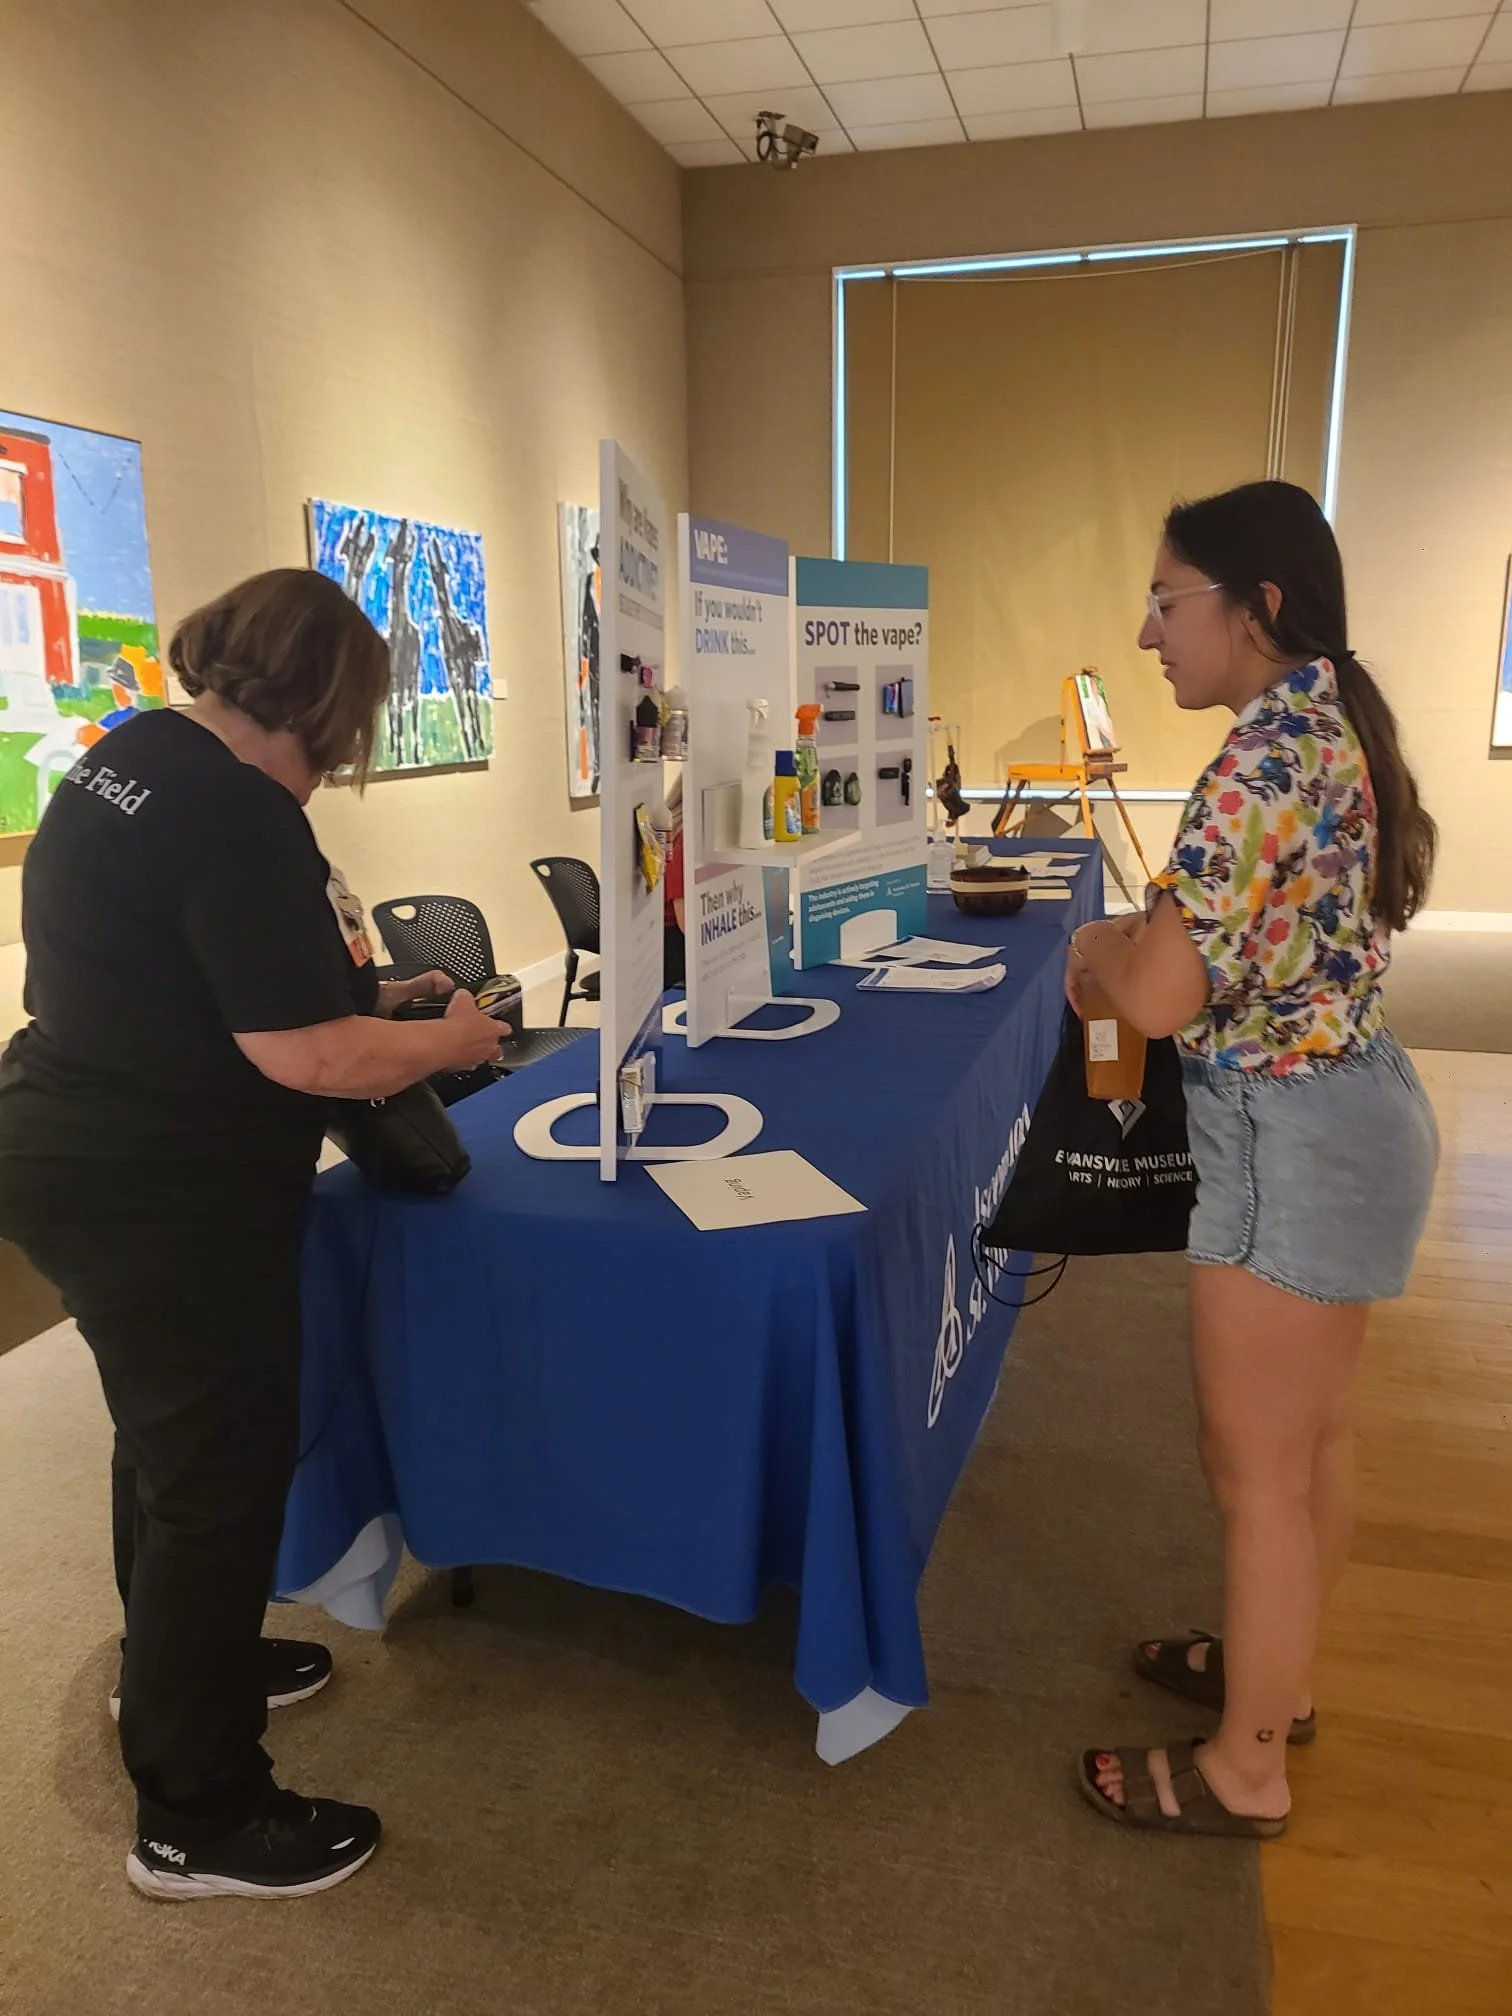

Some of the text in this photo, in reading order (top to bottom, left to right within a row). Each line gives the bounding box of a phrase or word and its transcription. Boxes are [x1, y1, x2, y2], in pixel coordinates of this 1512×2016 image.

[694, 529, 728, 565] VAPE:
[694, 590, 703, 616] If
[704, 599, 724, 623] you
[723, 596, 763, 622] wouldn't
[695, 628, 730, 654] DRINK
[805, 620, 922, 651] SPOT the vape?
[85, 766, 152, 816] Field
[700, 880, 744, 917] Then why
[700, 908, 738, 946] INHALE
[1153, 1170, 1193, 1185] SCIENCE
